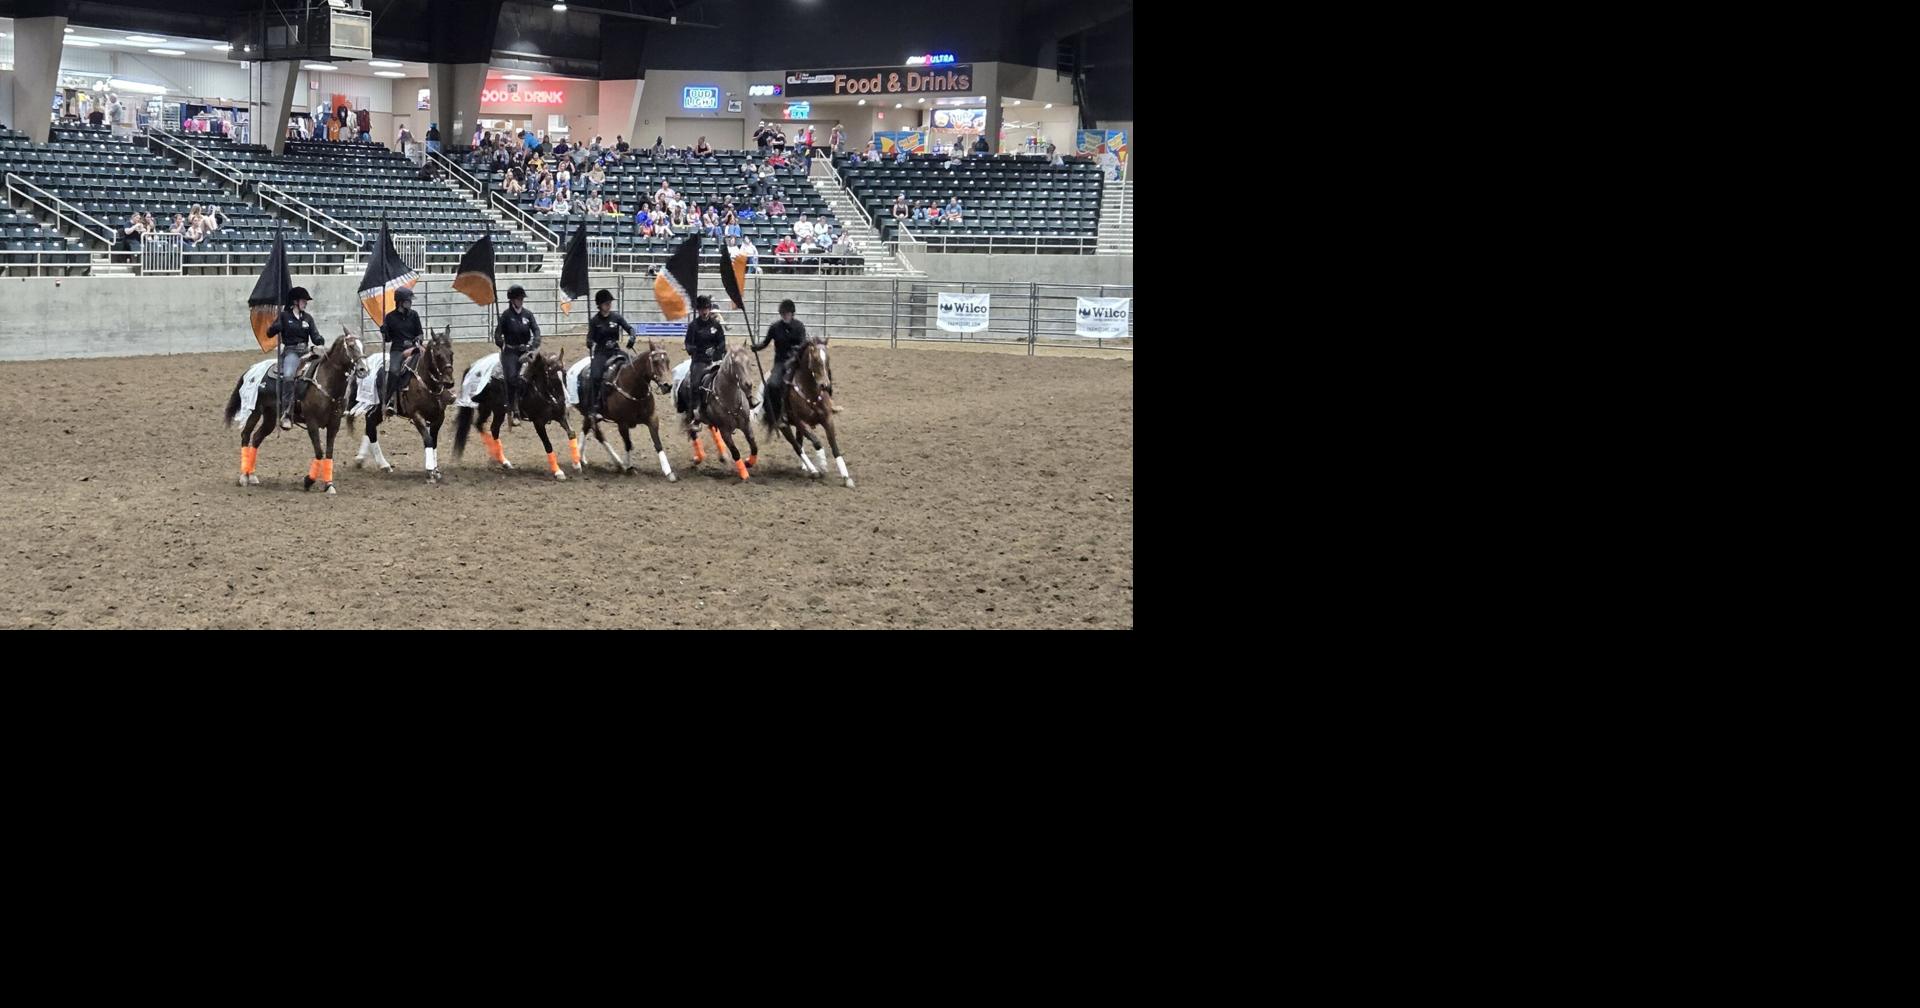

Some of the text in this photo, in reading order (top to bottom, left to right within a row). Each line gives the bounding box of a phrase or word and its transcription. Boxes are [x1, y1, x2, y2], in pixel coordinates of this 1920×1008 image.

[835, 74, 881, 93] Food
[887, 73, 901, 92] &
[907, 71, 969, 91] Drinks
[481, 90, 508, 102] OOD
[524, 91, 563, 103] DRINK
[690, 89, 712, 98] BUD
[685, 97, 715, 107] LIGHT
[954, 303, 987, 313] Wilco
[1092, 307, 1126, 318] Wilco
